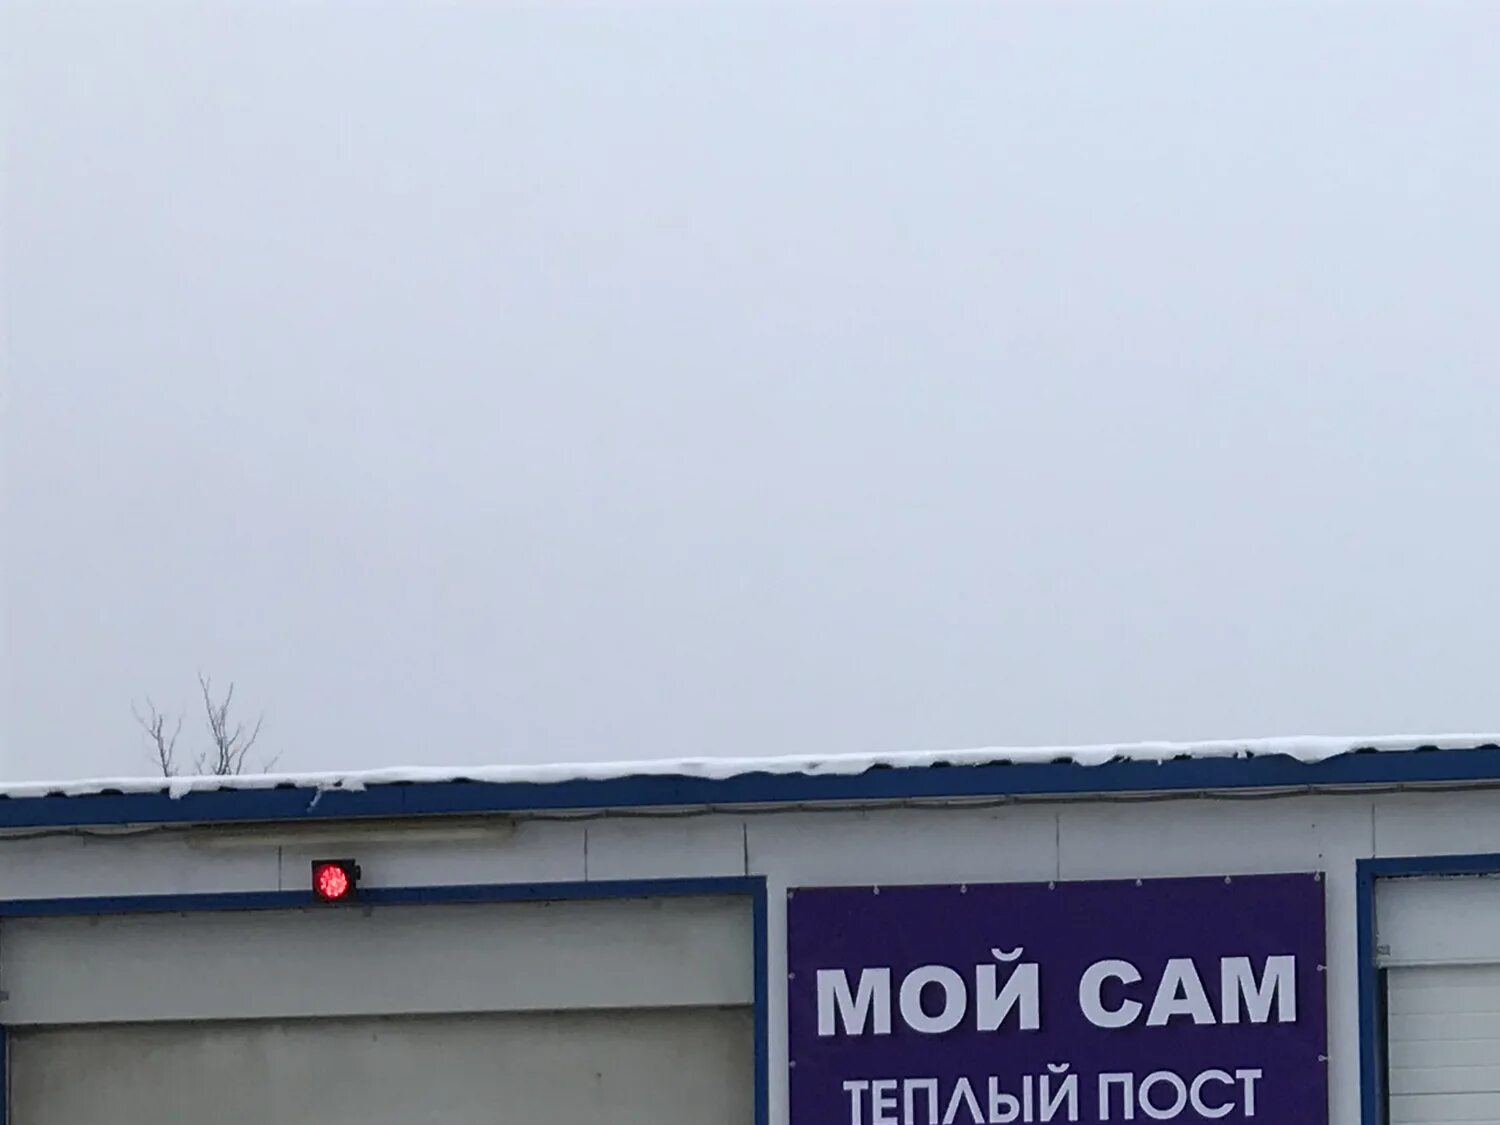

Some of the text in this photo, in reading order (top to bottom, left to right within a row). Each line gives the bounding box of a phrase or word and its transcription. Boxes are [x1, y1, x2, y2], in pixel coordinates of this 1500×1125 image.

[816, 946, 1297, 1037] МОЙ САМ
[1097, 1068, 1263, 1122] ПОСТ
